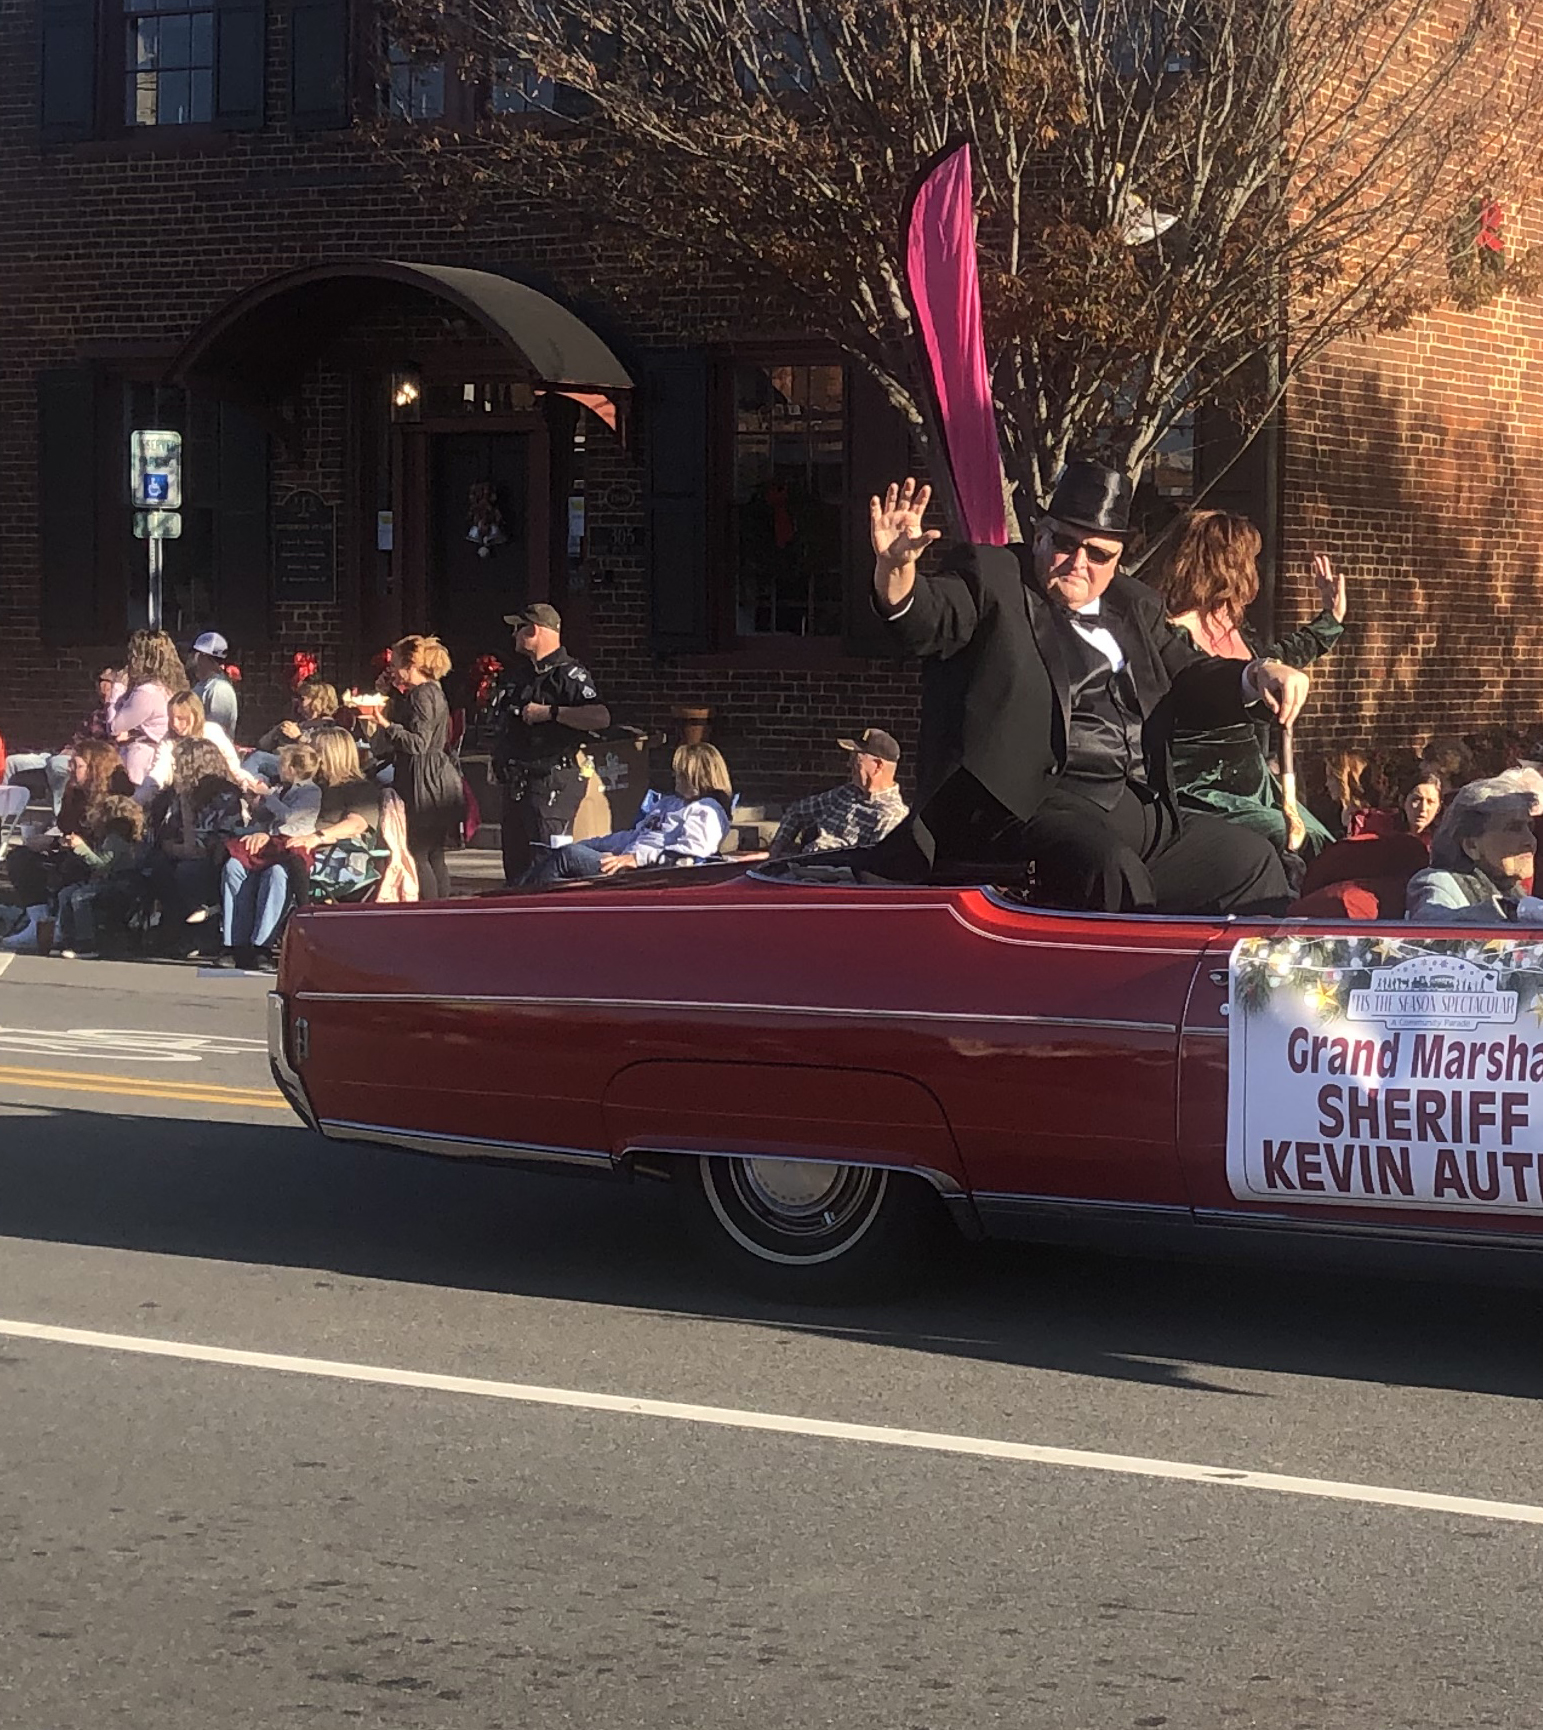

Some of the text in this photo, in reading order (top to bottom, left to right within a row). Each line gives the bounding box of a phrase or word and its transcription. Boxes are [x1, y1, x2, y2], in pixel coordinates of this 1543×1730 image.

[611, 528, 635, 545] 305
[1374, 994, 1392, 1012] THE
[1399, 995, 1436, 1013] SEASON
[1441, 995, 1515, 1014] SPECTACULAR
[1400, 1019, 1442, 1029] Community
[1444, 1019, 1471, 1028] Parade
[1287, 1026, 1400, 1079] Grand
[1317, 1083, 1530, 1146] SHERIFF
[1262, 1139, 1415, 1197] KEVIN
